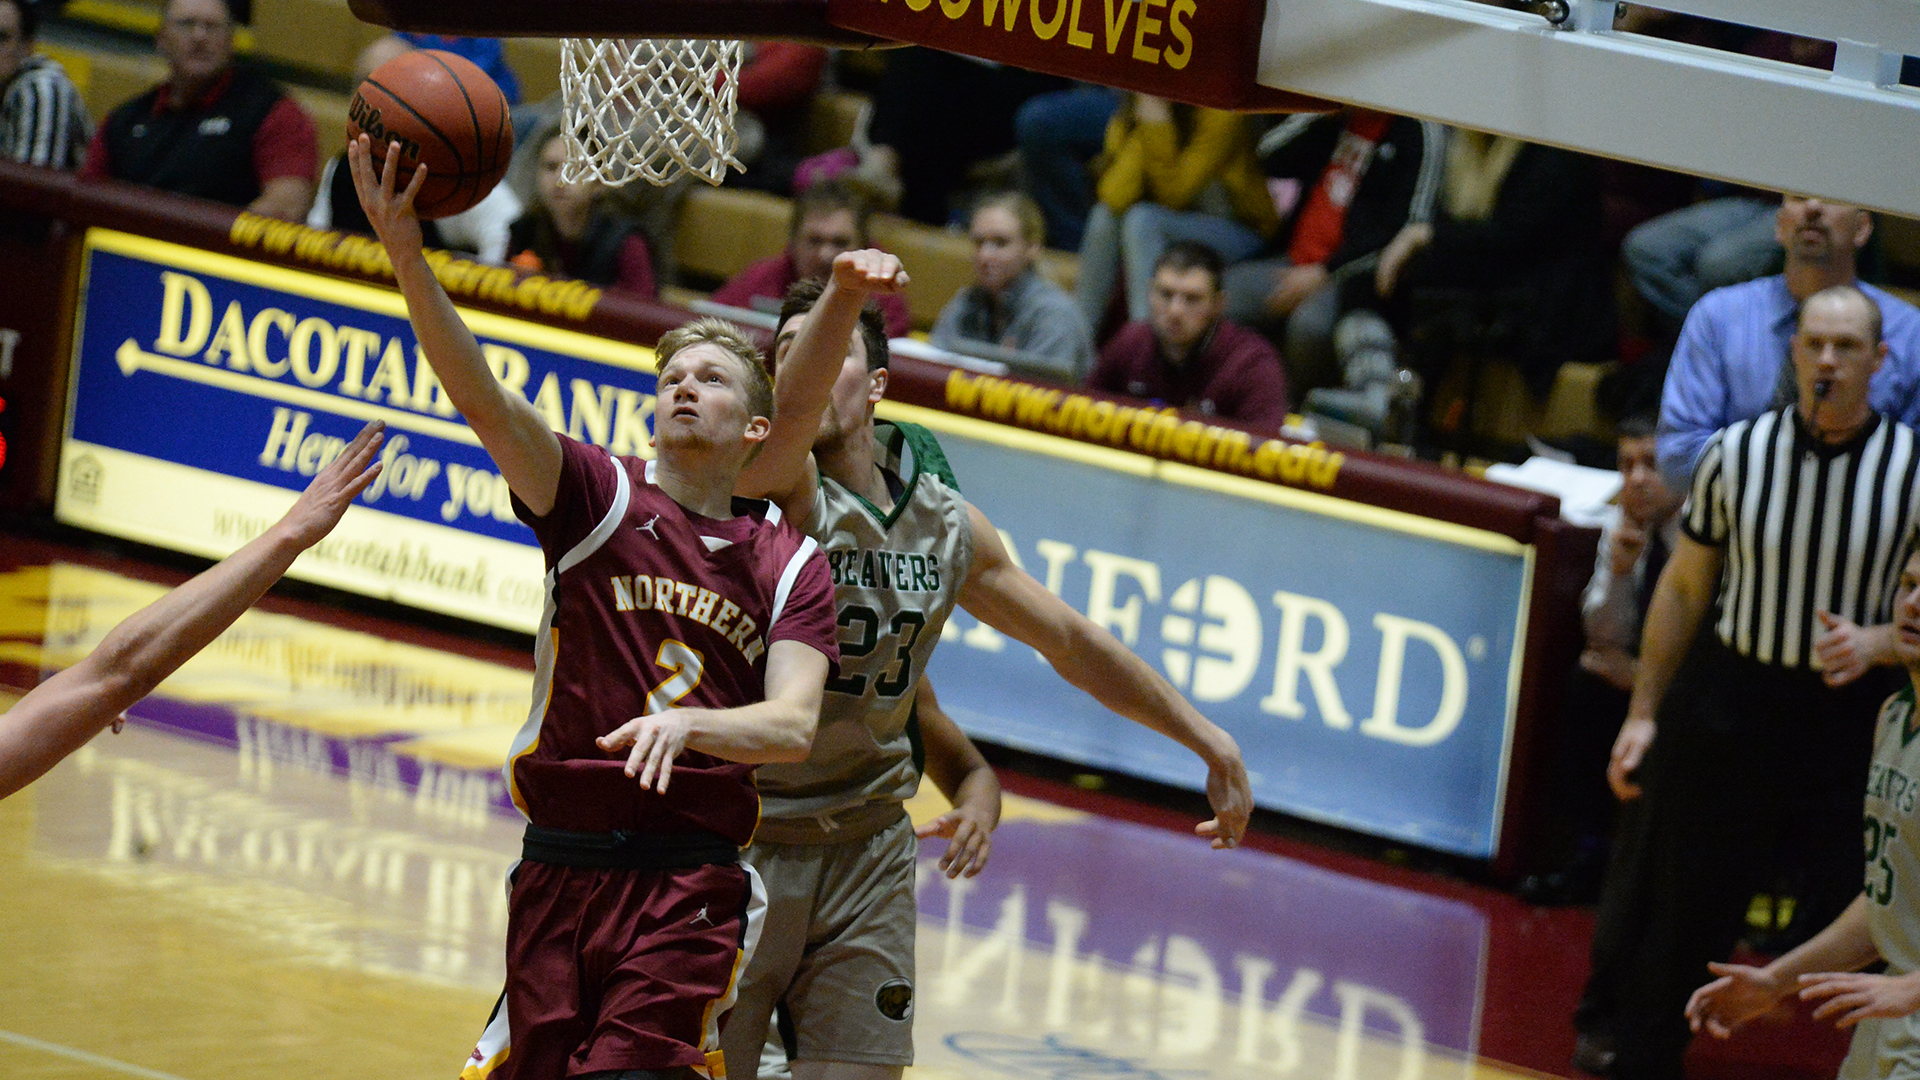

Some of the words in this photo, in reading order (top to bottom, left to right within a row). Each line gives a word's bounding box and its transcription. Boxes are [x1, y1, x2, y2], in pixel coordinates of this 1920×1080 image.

[880, 0, 1197, 70] OLVES
[153, 270, 459, 419] DACOTAH
[259, 406, 352, 478] Her
[362, 434, 440, 503] for
[945, 369, 1346, 490] www.northern.edu
[828, 549, 940, 592] BEAVERS
[611, 575, 765, 667] NORTHERN
[825, 604, 926, 698] 23
[643, 638, 705, 716] 2
